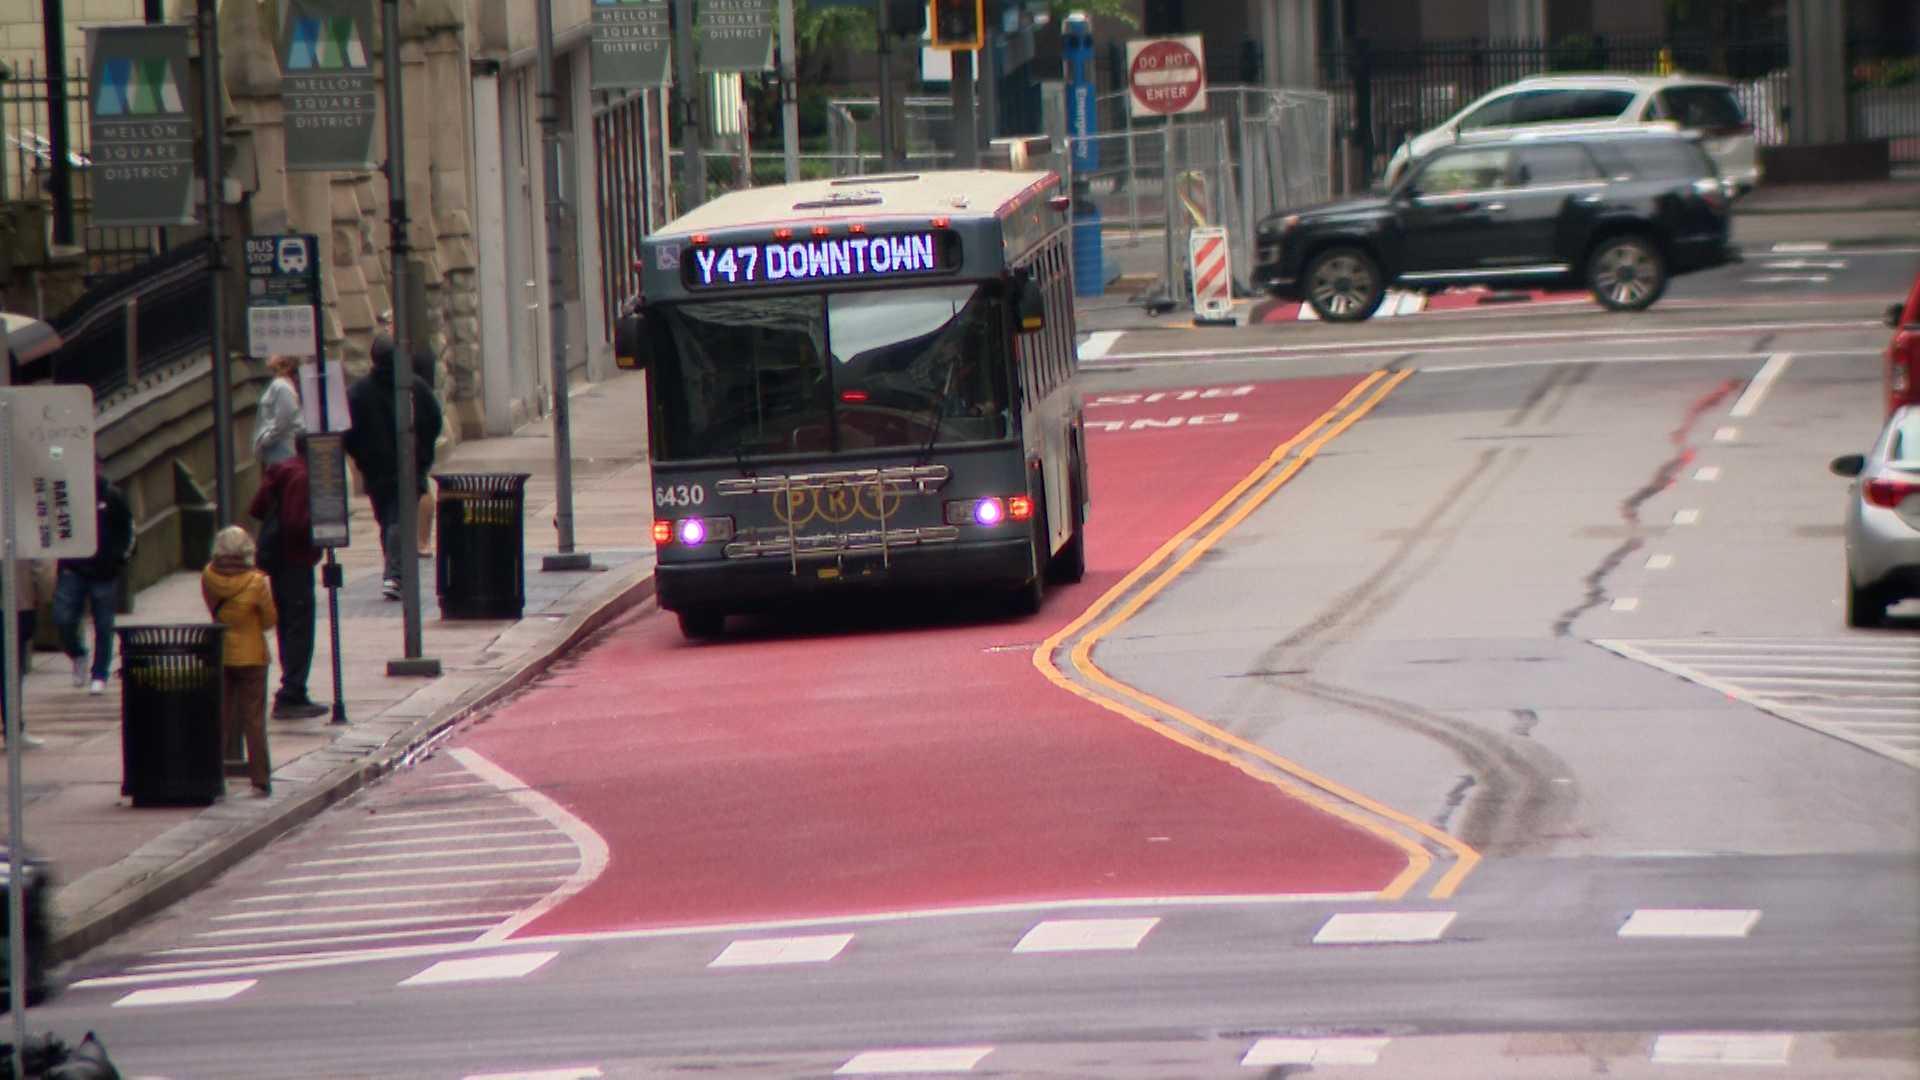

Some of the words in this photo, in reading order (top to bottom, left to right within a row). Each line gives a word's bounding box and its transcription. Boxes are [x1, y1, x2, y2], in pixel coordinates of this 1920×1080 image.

[602, 10, 657, 21] MELLON
[709, 15, 762, 25] SQUARE
[602, 26, 657, 37] SQUARE
[709, 29, 762, 39] DISTRICT
[602, 41, 659, 53] DISTRICT
[1138, 56, 1157, 68] DO
[1164, 53, 1191, 66] NOT
[296, 78, 362, 91] MELLON
[1145, 86, 1188, 100] ENTER
[296, 96, 362, 109] SQUARE
[296, 115, 362, 129] DISTRICT
[103, 124, 178, 138] MELLON
[104, 144, 178, 158] SQUARE
[104, 165, 179, 180] DISTRICT
[246, 239, 274, 252] BUS
[247, 253, 274, 264] STOP
[696, 246, 757, 284] Y47
[765, 233, 934, 280] DOWNTOWN
[655, 484, 704, 507] 6430
